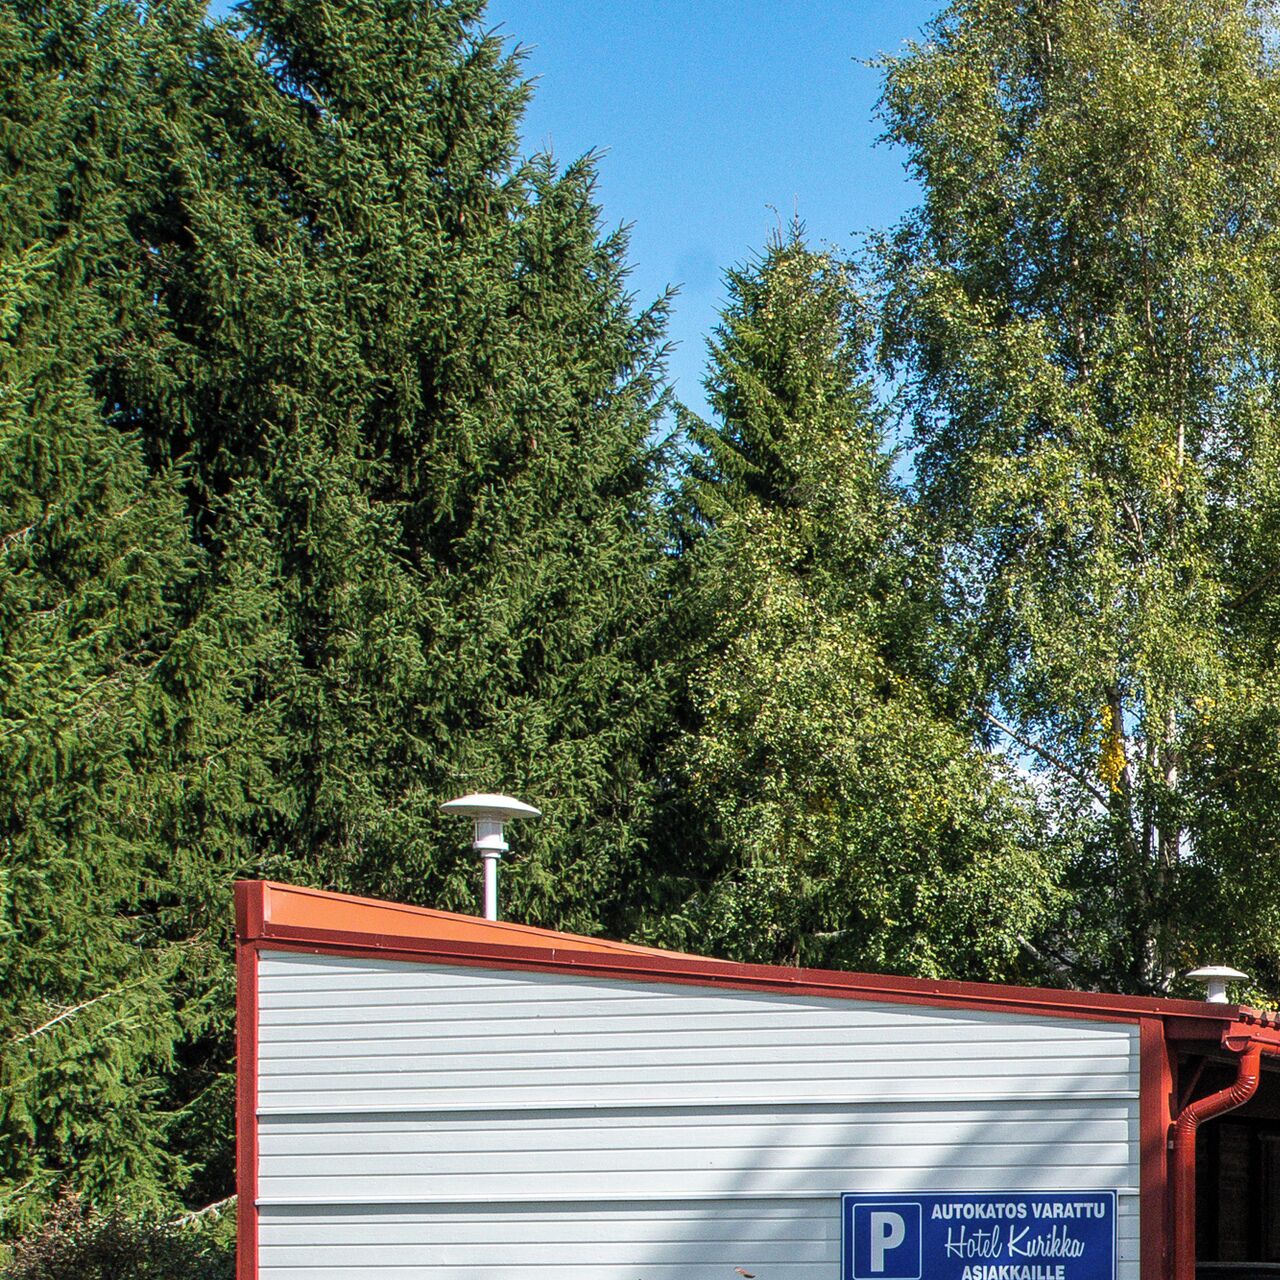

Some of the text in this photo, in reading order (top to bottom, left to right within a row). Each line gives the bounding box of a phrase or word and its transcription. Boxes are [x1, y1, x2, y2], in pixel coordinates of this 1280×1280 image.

[931, 1202, 1105, 1220] AUTOKATOS VARATTU
[871, 1211, 906, 1272] P
[944, 1224, 1085, 1258] Hotel Kurikka
